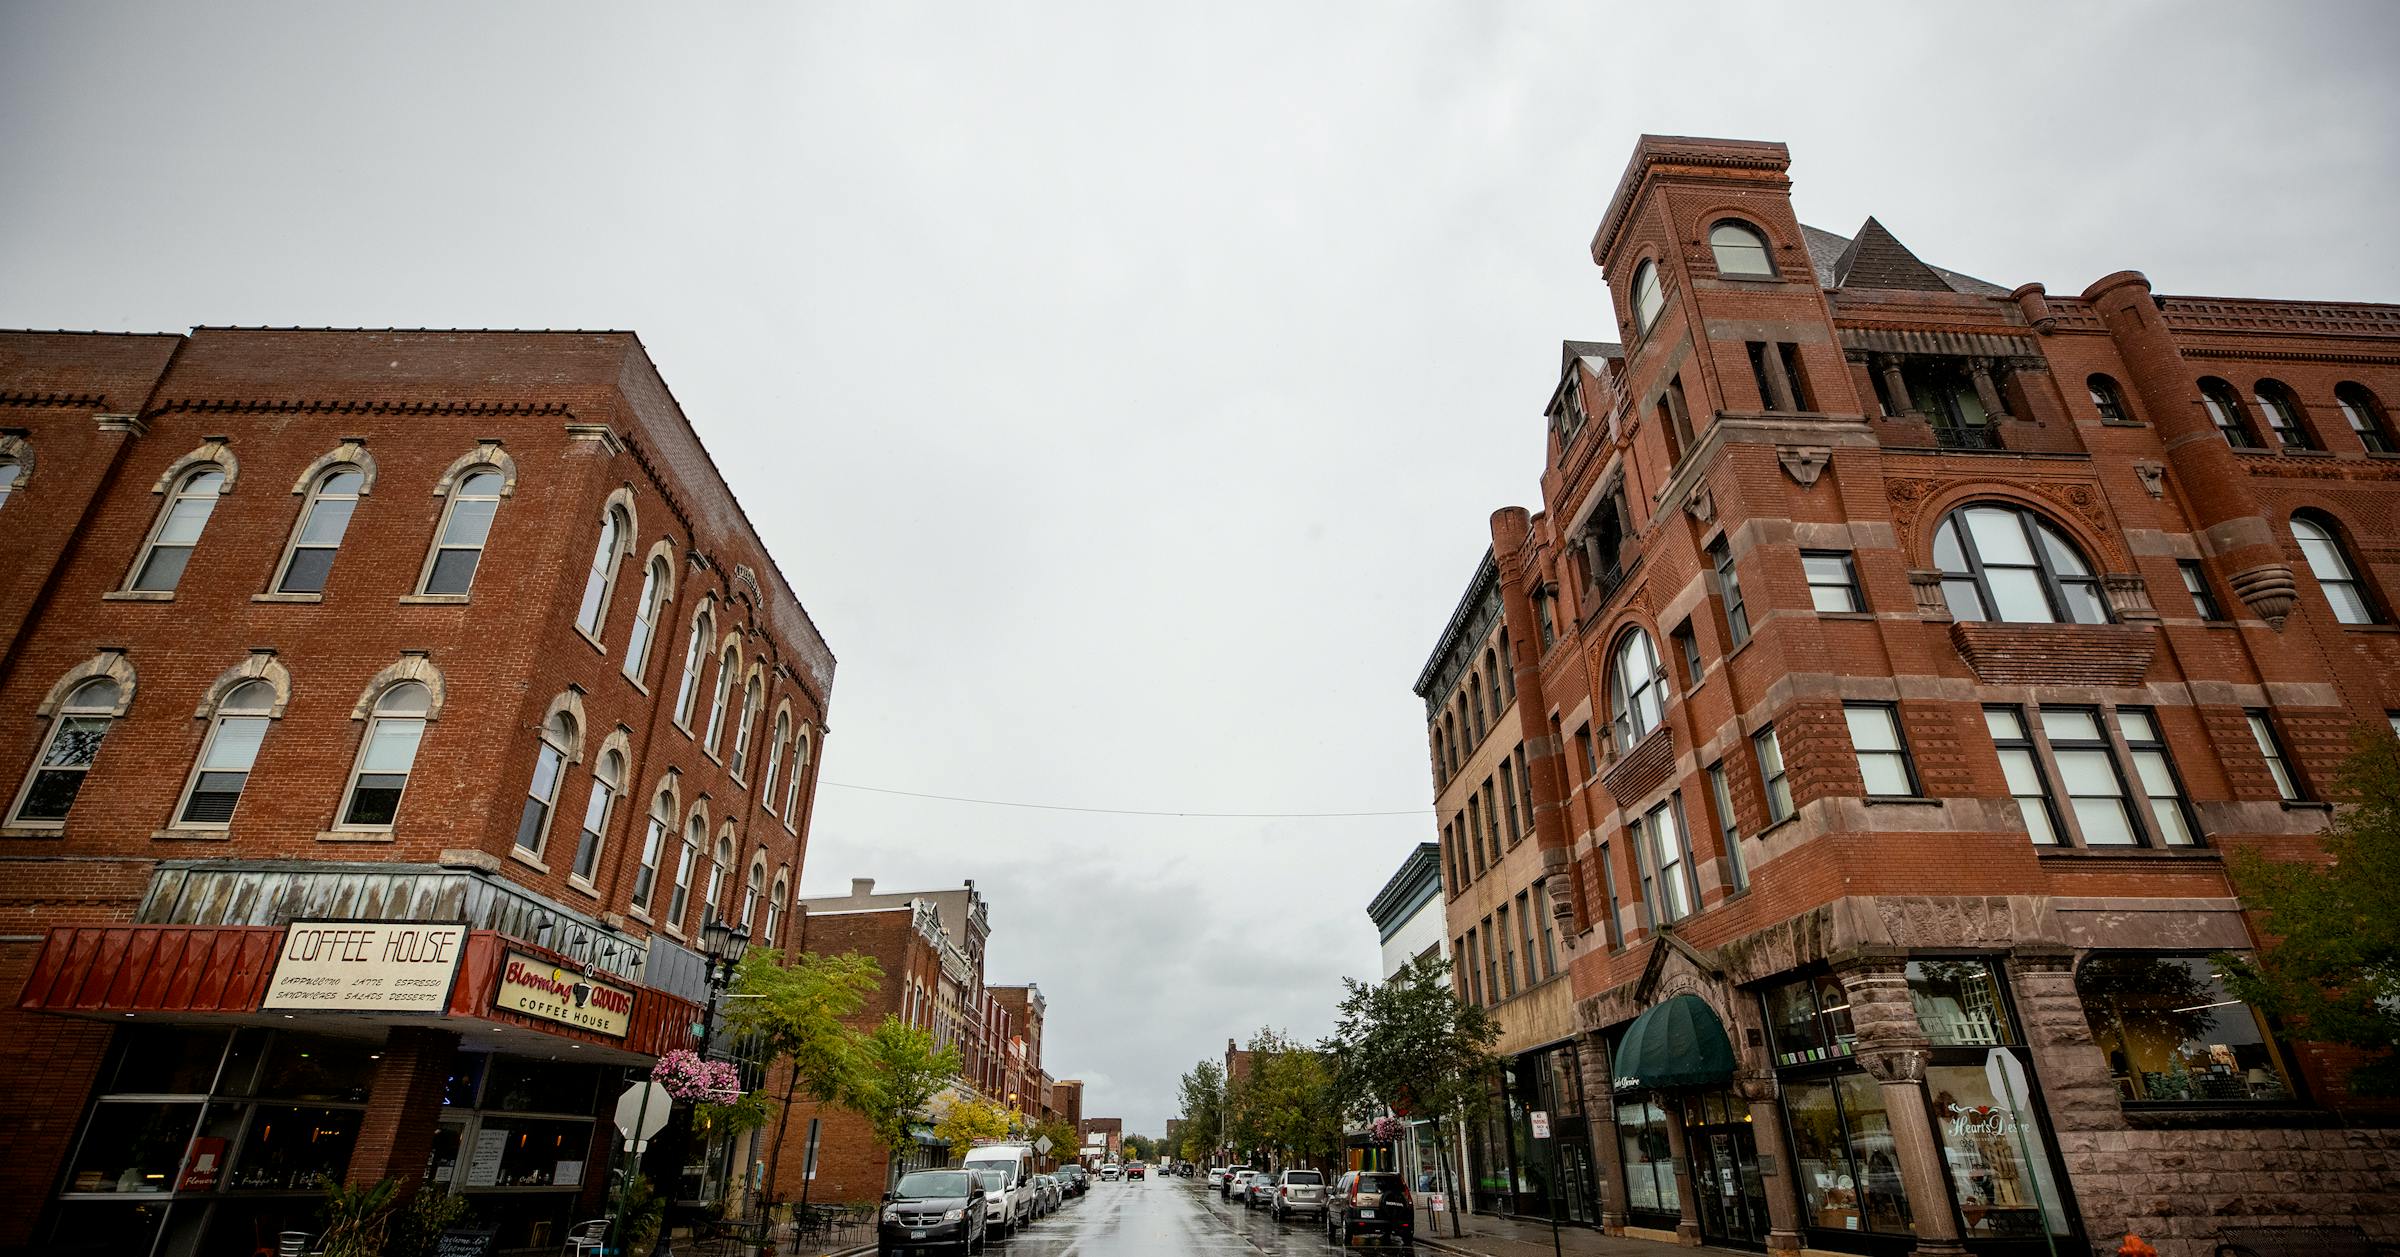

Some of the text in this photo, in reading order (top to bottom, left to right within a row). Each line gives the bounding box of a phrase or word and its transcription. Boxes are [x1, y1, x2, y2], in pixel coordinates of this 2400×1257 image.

[288, 930, 456, 963] COFFEE HOUSE
[280, 977, 442, 987] CAPPUCCINO LATTE ESPRESSO
[505, 961, 573, 1005] Blooming
[275, 991, 438, 1002] SANDWICHES SALADS DESSERTS
[519, 997, 611, 1030] COFFEE HOUSE
[1948, 1114, 2030, 1137] Heart's Desre
[1385, 1200, 1404, 1208] HONDA
